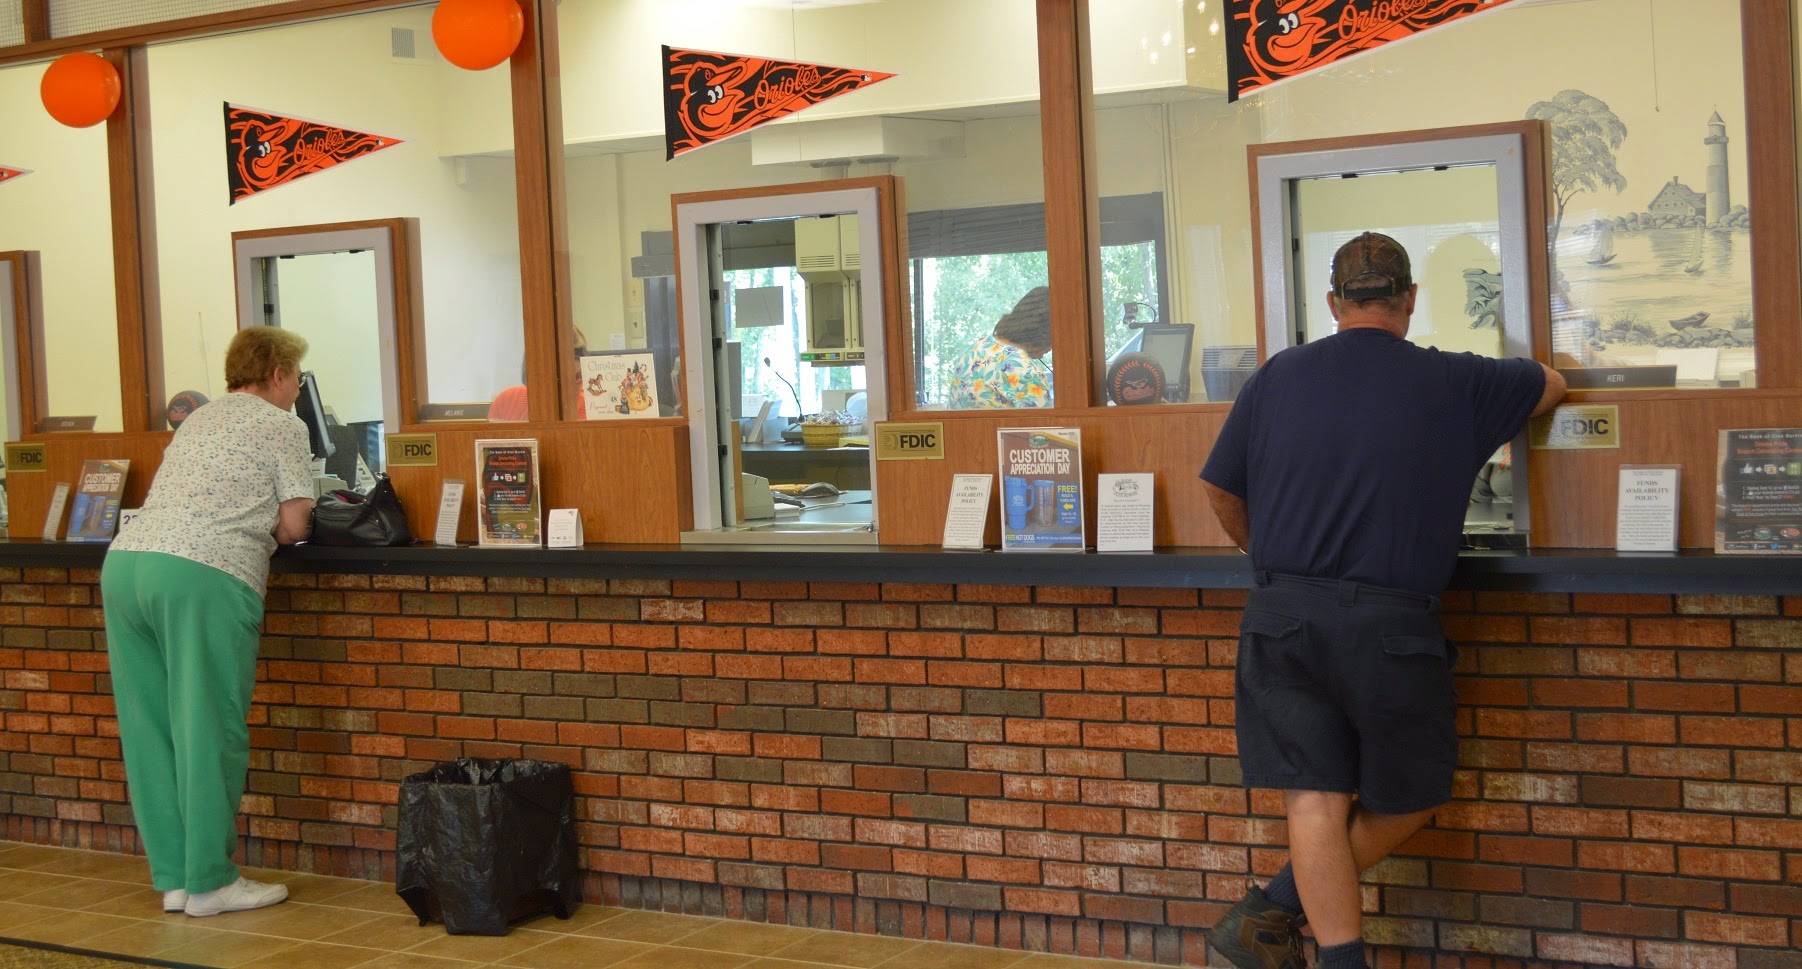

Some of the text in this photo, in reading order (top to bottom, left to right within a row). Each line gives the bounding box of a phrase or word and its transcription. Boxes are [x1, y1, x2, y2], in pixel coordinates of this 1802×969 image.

[754, 66, 821, 110] Orioles
[293, 129, 346, 166] Orioles
[588, 360, 625, 372] Christmas
[1560, 419, 1609, 435] FDIC
[900, 434, 936, 448] FDIC
[405, 444, 432, 456] FDIC
[1010, 449, 1070, 463] CUSTOMER
[20, 453, 42, 463] FDIC
[1010, 463, 1070, 475] APPRECIATION DAY
[84, 473, 121, 484] CUSTOMER
[1058, 485, 1078, 493] FREE!
